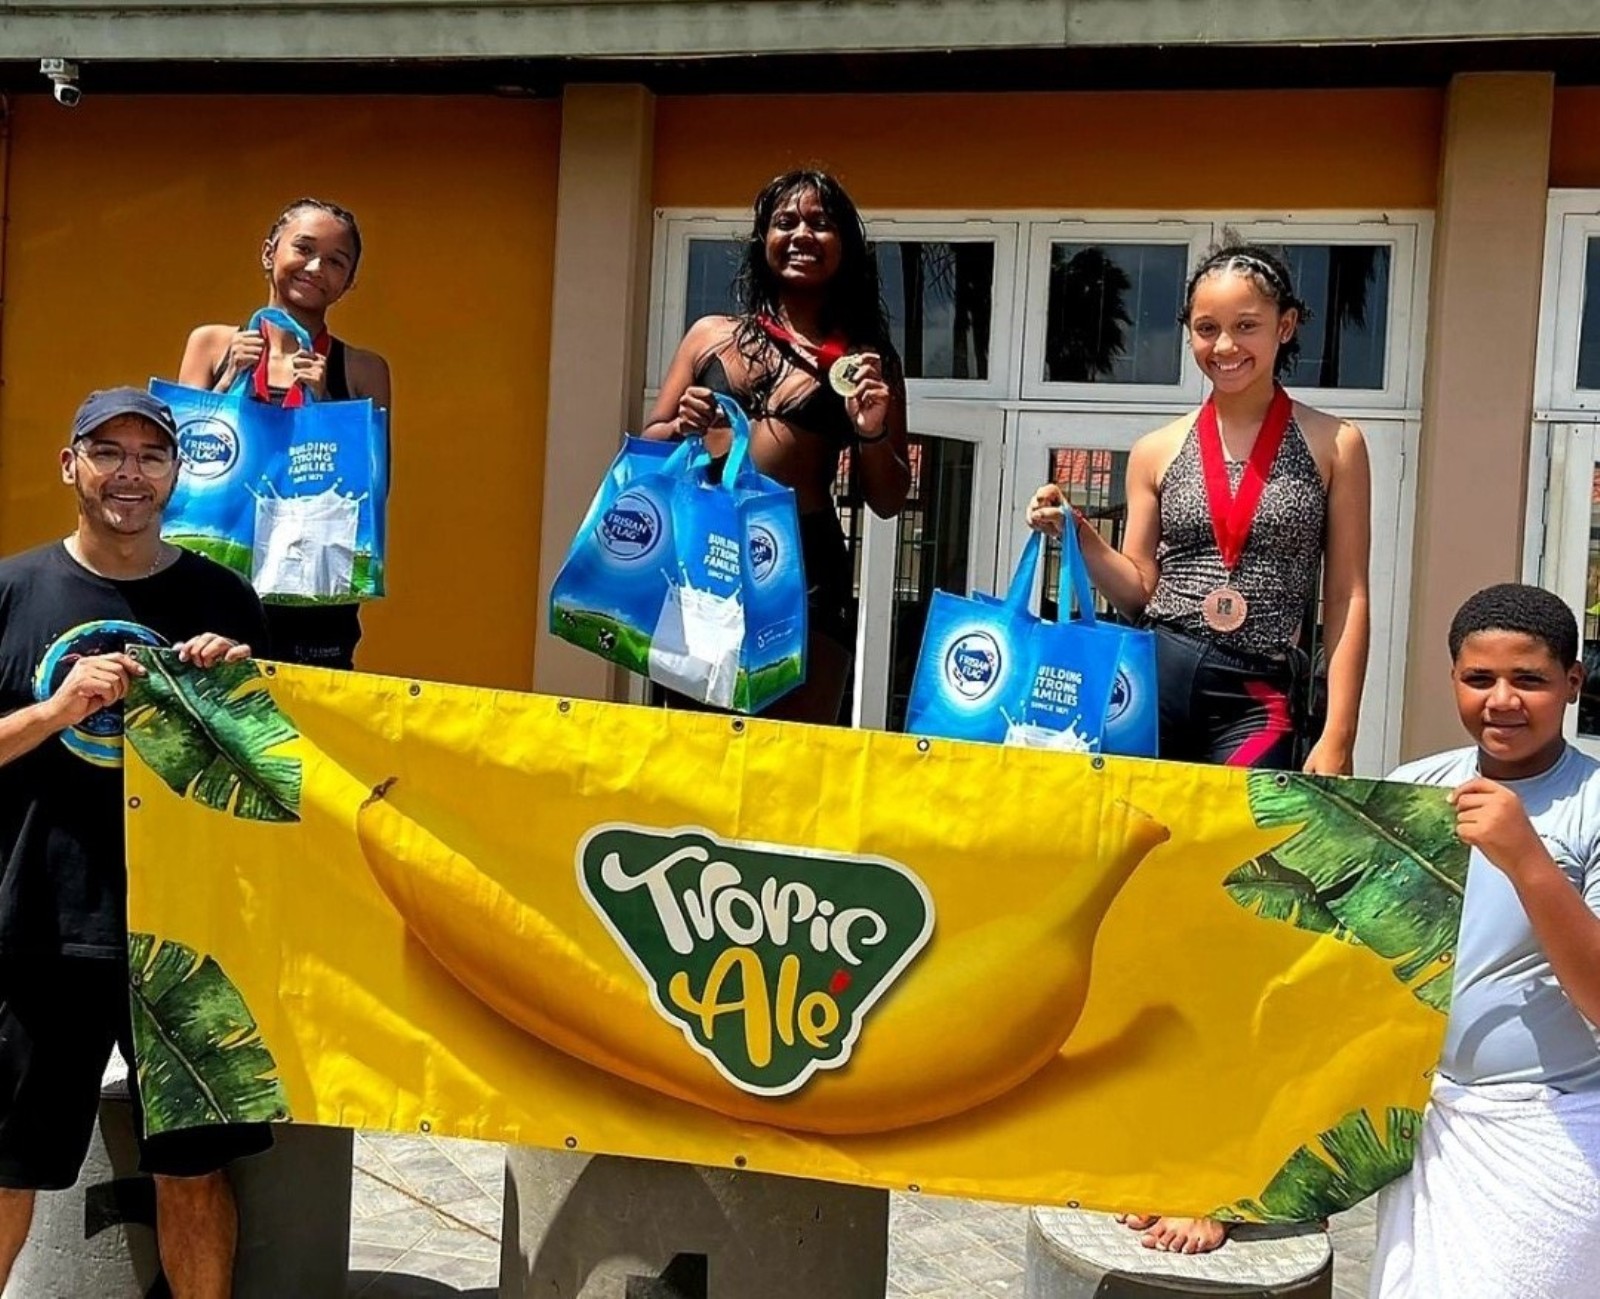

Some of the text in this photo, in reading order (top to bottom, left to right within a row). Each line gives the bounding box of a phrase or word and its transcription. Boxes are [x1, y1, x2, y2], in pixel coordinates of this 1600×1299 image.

[184, 439, 226, 453] FRISIAN
[191, 448, 217, 460] FLAG
[608, 513, 648, 534] FRISIAN
[611, 525, 637, 540] FLAG
[958, 654, 989, 671] FRISIAN
[962, 665, 982, 680] FLAG
[1031, 688, 1078, 707] AMILIES
[601, 846, 887, 966] Tropic
[669, 947, 851, 1067] Alé
